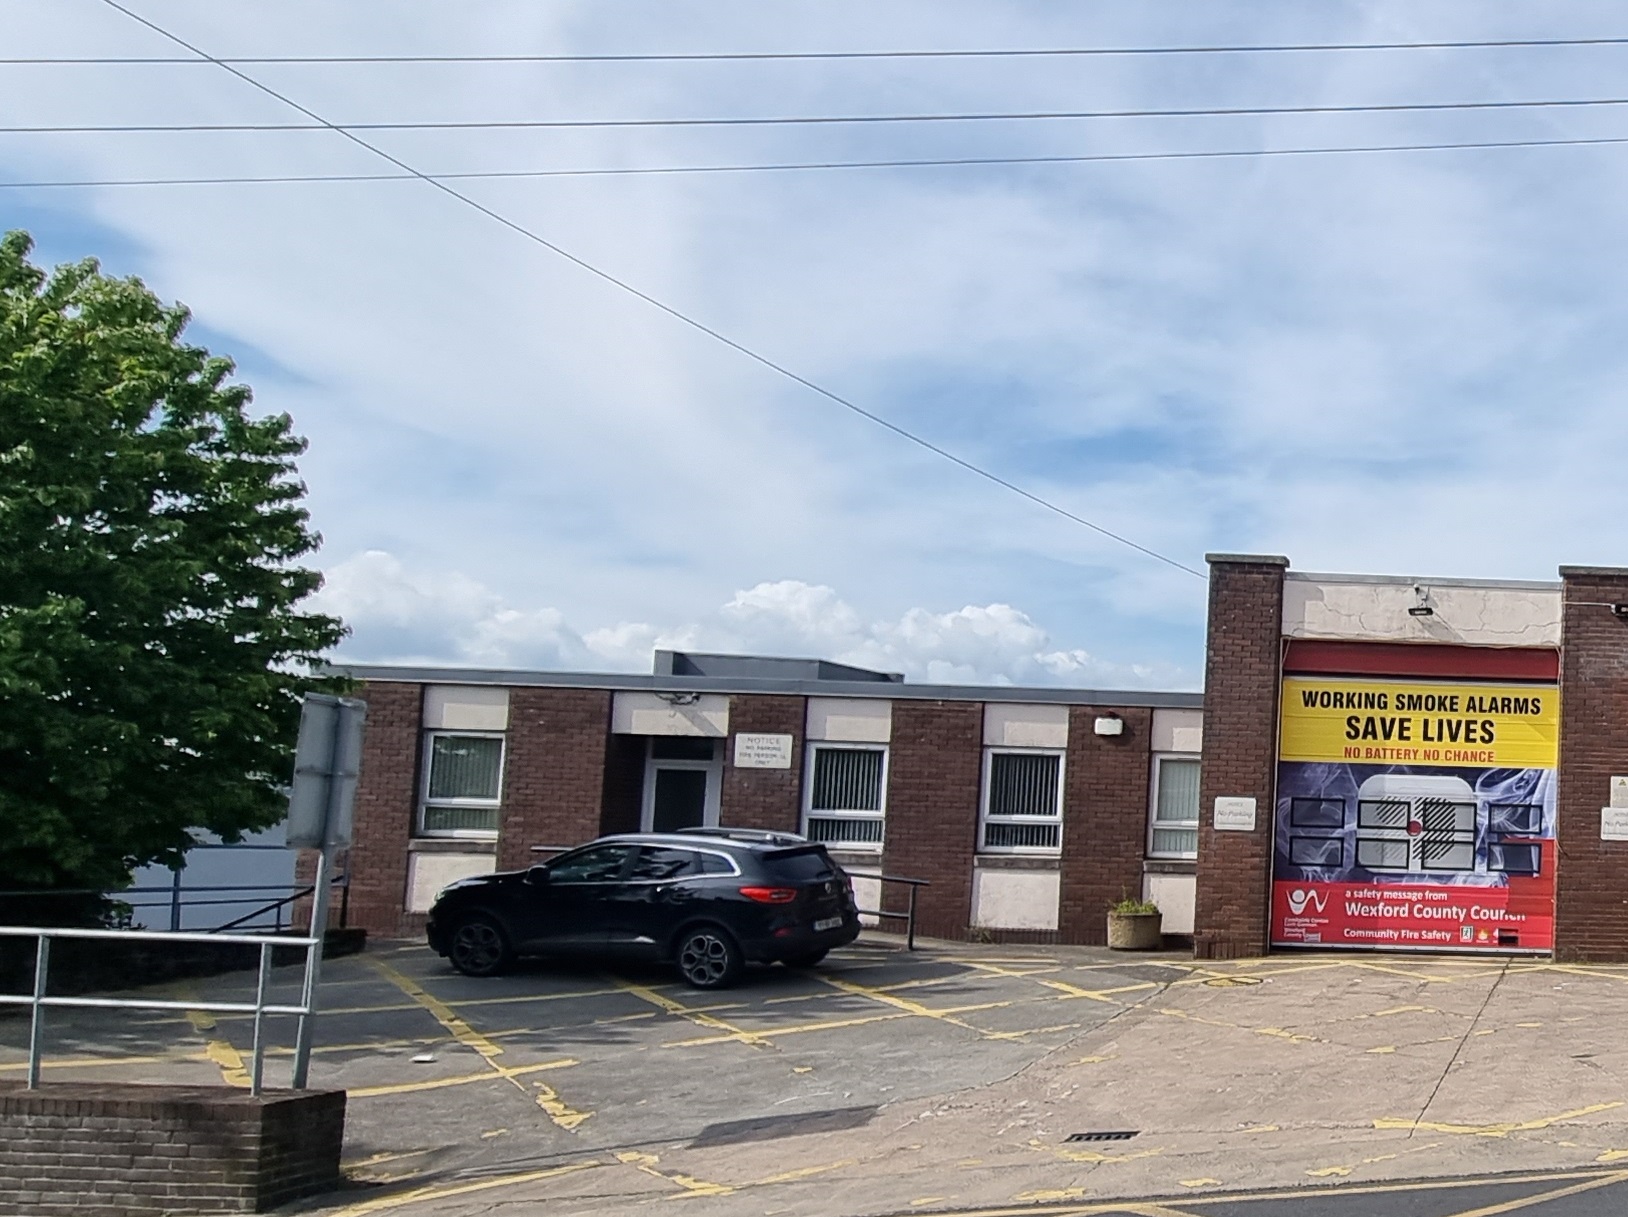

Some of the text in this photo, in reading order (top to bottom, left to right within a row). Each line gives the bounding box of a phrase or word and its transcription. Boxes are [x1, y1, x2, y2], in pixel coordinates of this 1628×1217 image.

[1302, 690, 1541, 716] WORKING SMOKE ALARMS
[1345, 715, 1495, 745] SAVE LIVES
[1344, 746, 1495, 763] NO BATTERY NO CHANCE
[1345, 888, 1447, 901] a safety message from
[1345, 902, 1526, 922] Wexford County Coun
[1344, 928, 1451, 942] Community Fire Safety
